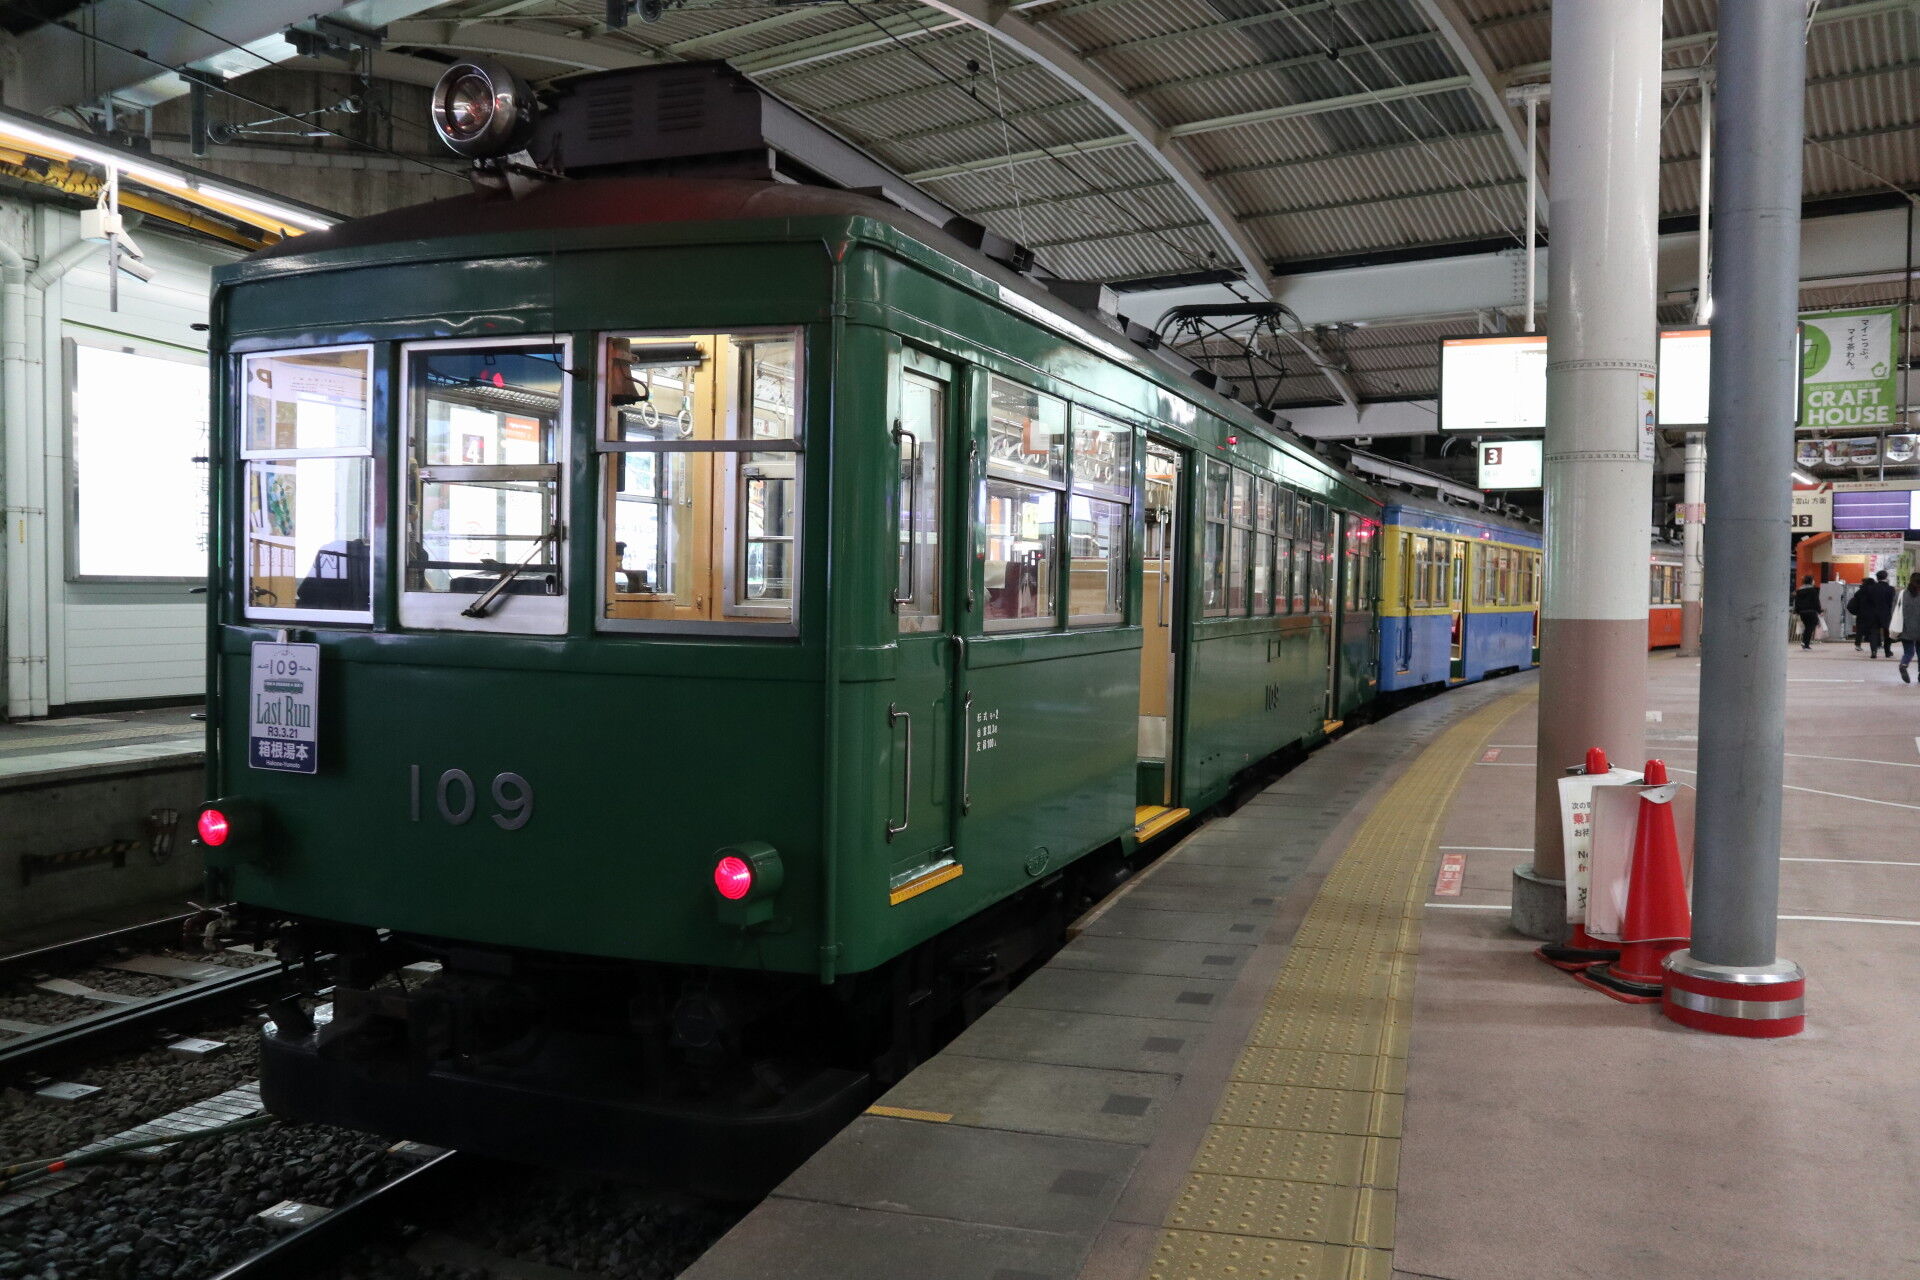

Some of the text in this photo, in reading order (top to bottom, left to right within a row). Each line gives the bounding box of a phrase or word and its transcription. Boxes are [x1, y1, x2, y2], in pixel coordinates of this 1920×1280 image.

[1807, 387, 1882, 408] CRAFT
[1807, 405, 1890, 425] HOUSE
[1487, 448, 1499, 465] 3
[1801, 515, 1810, 526] 3
[270, 659, 298, 676] 109
[256, 693, 311, 728] Last Run
[267, 726, 299, 739] R3.3.21
[258, 740, 309, 761] 箱根湯本
[410, 764, 534, 831] 109
